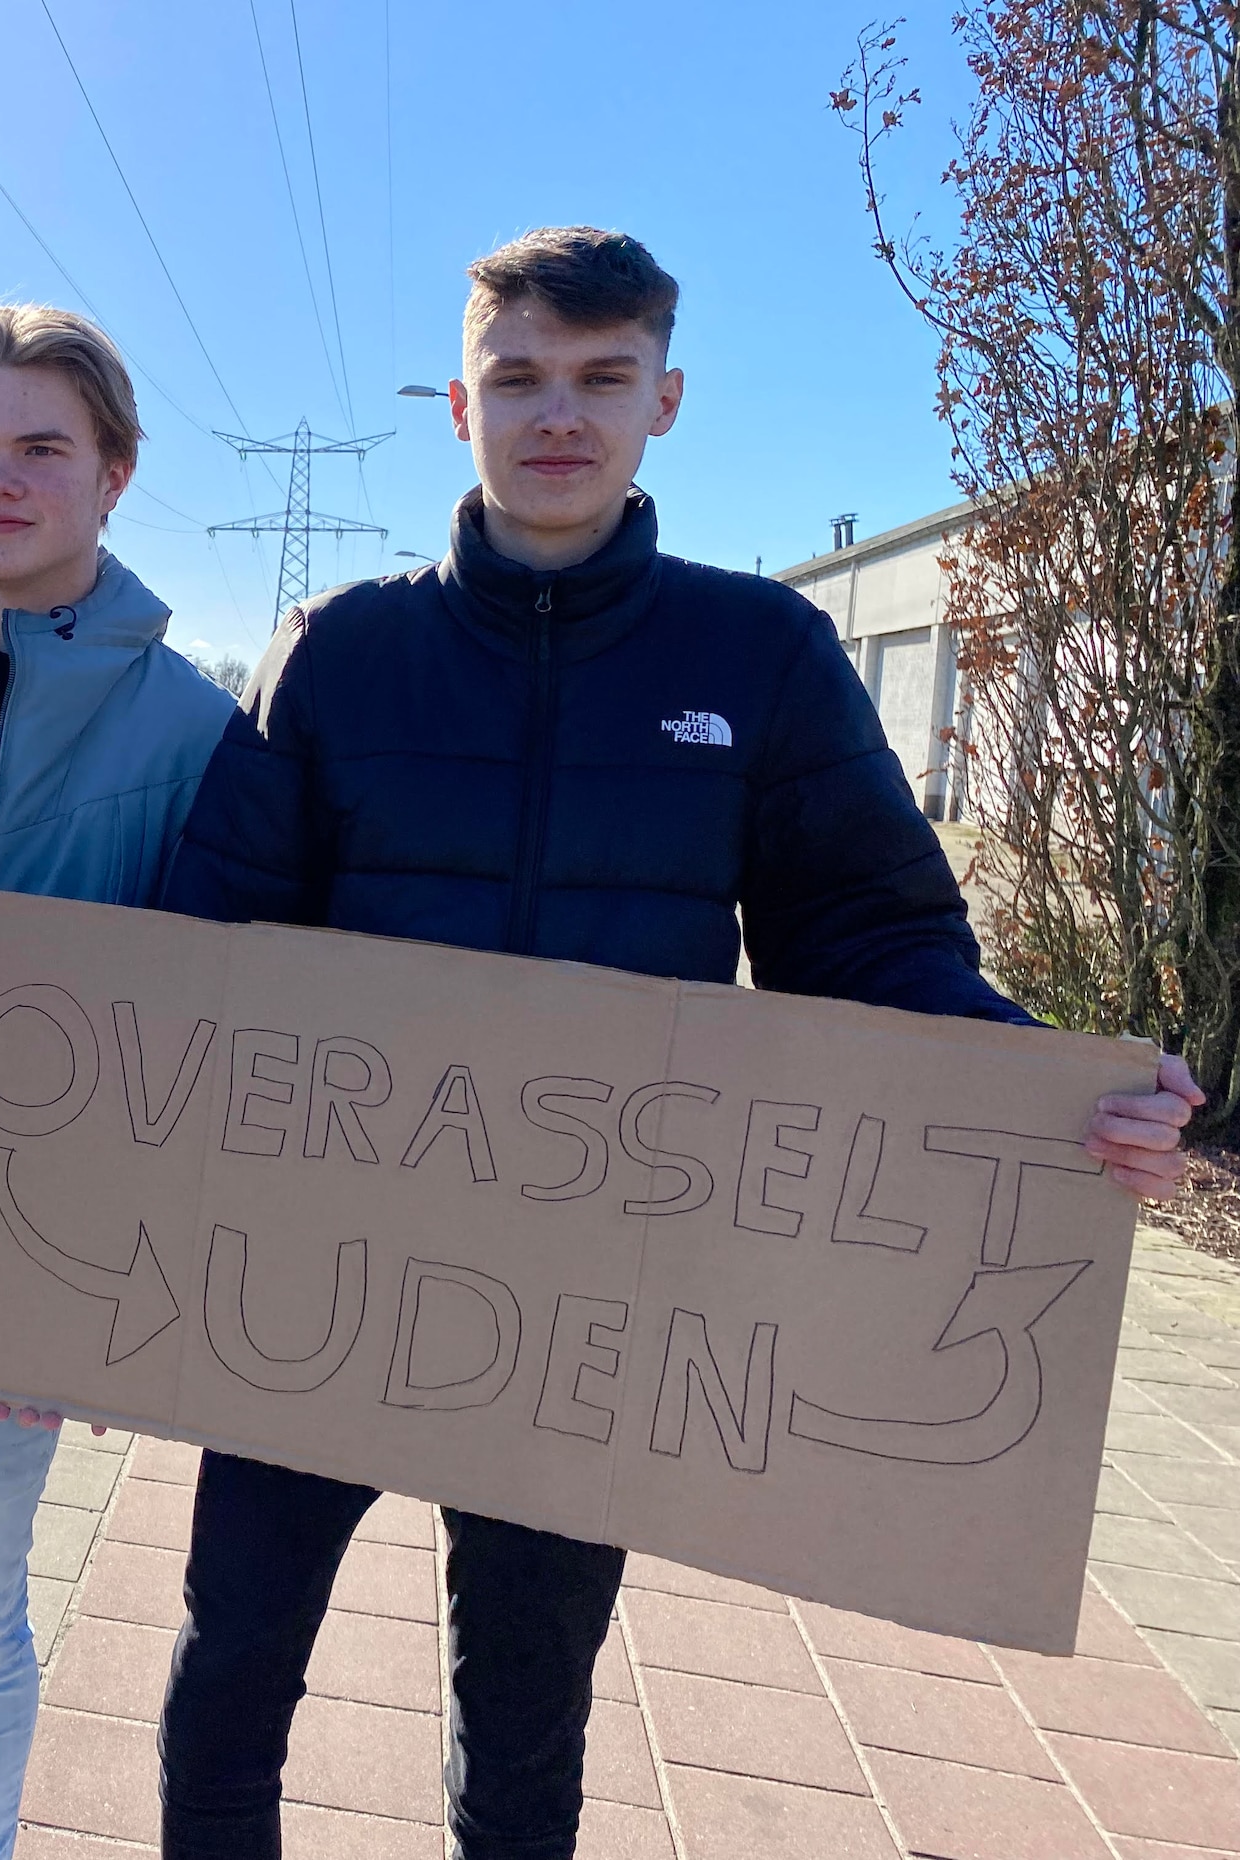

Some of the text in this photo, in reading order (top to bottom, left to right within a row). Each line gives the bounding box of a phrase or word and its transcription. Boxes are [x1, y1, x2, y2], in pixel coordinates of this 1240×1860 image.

[683, 710, 710, 723] THE
[661, 720, 710, 733] NORTH
[674, 731, 709, 744] FACE
[203, 1223, 779, 1475] UDEN
